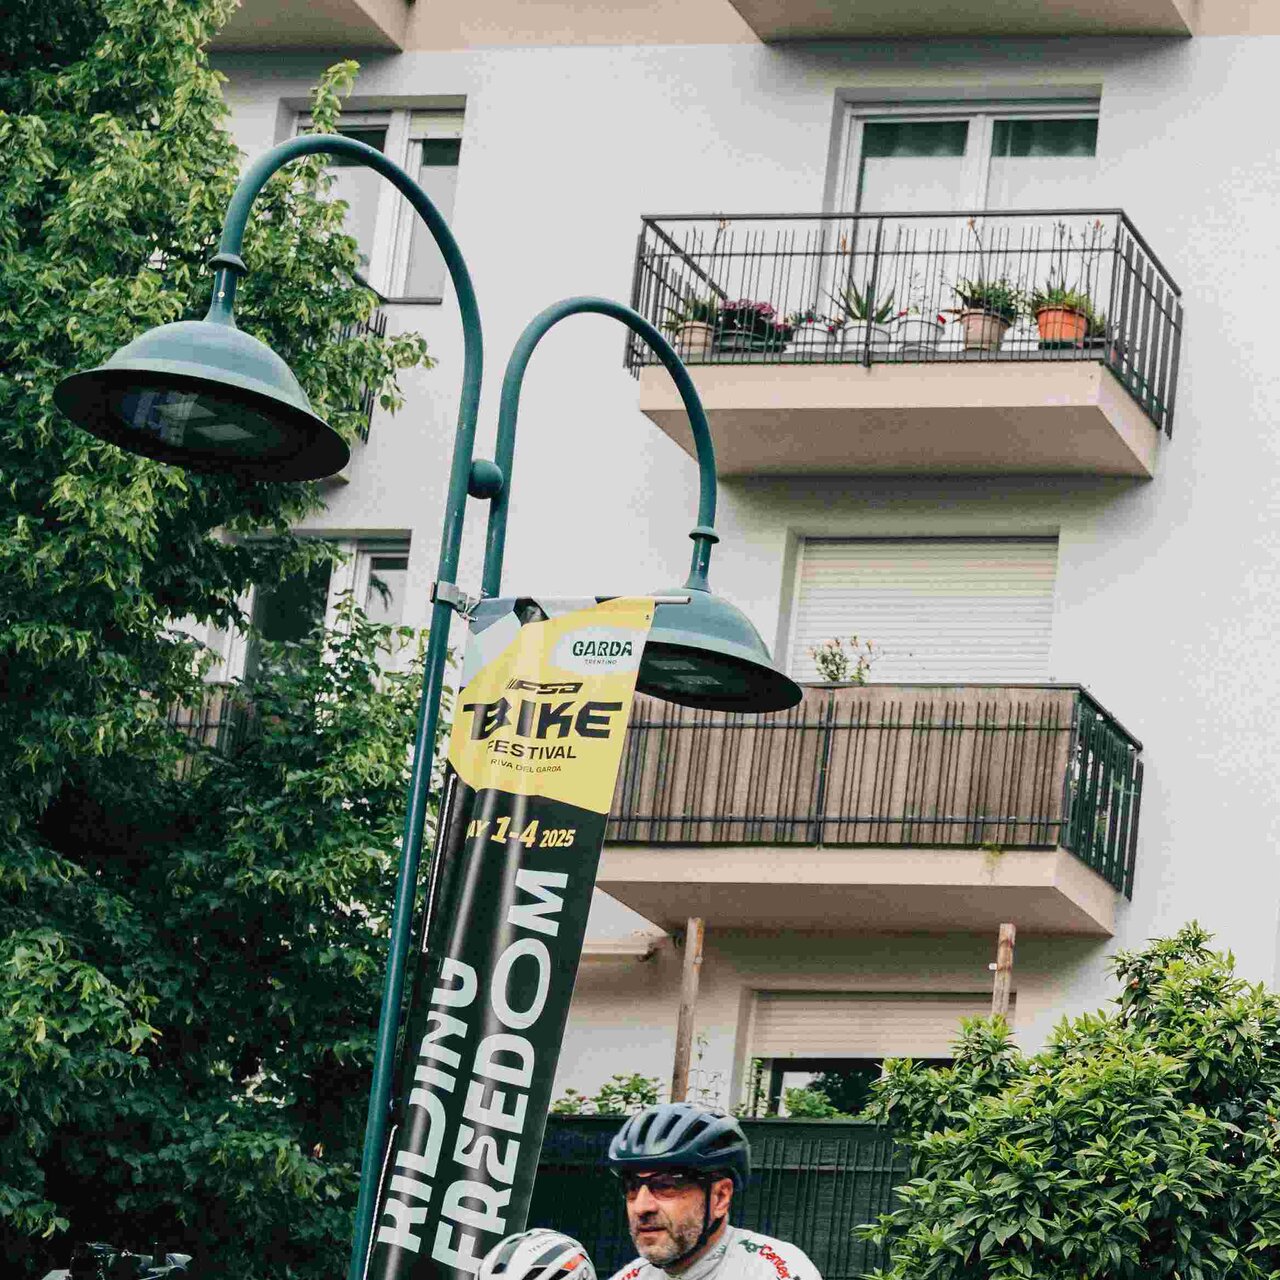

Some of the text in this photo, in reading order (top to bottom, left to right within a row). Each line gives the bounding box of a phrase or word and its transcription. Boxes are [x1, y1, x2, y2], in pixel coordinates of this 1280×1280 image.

[572, 640, 633, 658] GARDA
[462, 697, 623, 741] BIKE
[487, 739, 577, 760] FESTIVAL
[490, 758, 514, 769] RIVA
[535, 765, 562, 773] GARDA
[539, 829, 576, 848] 2025
[432, 868, 568, 1274] FREEDOM
